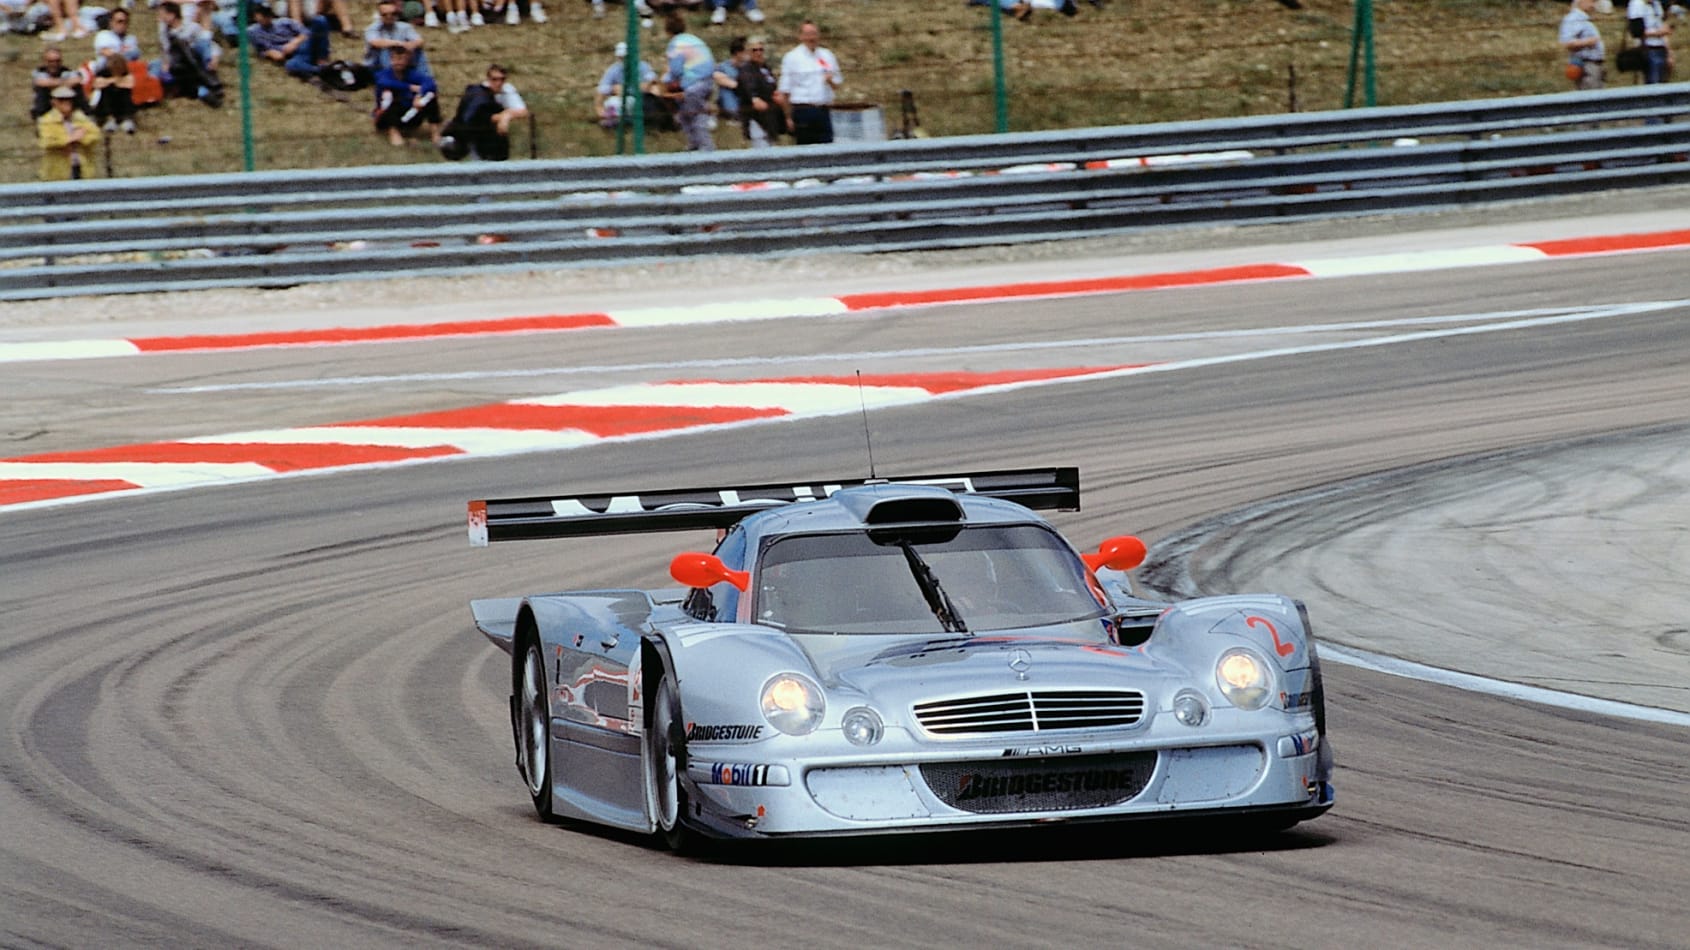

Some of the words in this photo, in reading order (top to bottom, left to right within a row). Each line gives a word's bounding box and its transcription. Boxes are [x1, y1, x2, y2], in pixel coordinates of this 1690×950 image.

[687, 722, 764, 740] BRIDGESTONE
[1025, 745, 1082, 757] AMG
[712, 762, 752, 785] Mobil
[755, 764, 767, 785] 1
[957, 769, 1134, 800] BRIDGESTONE
